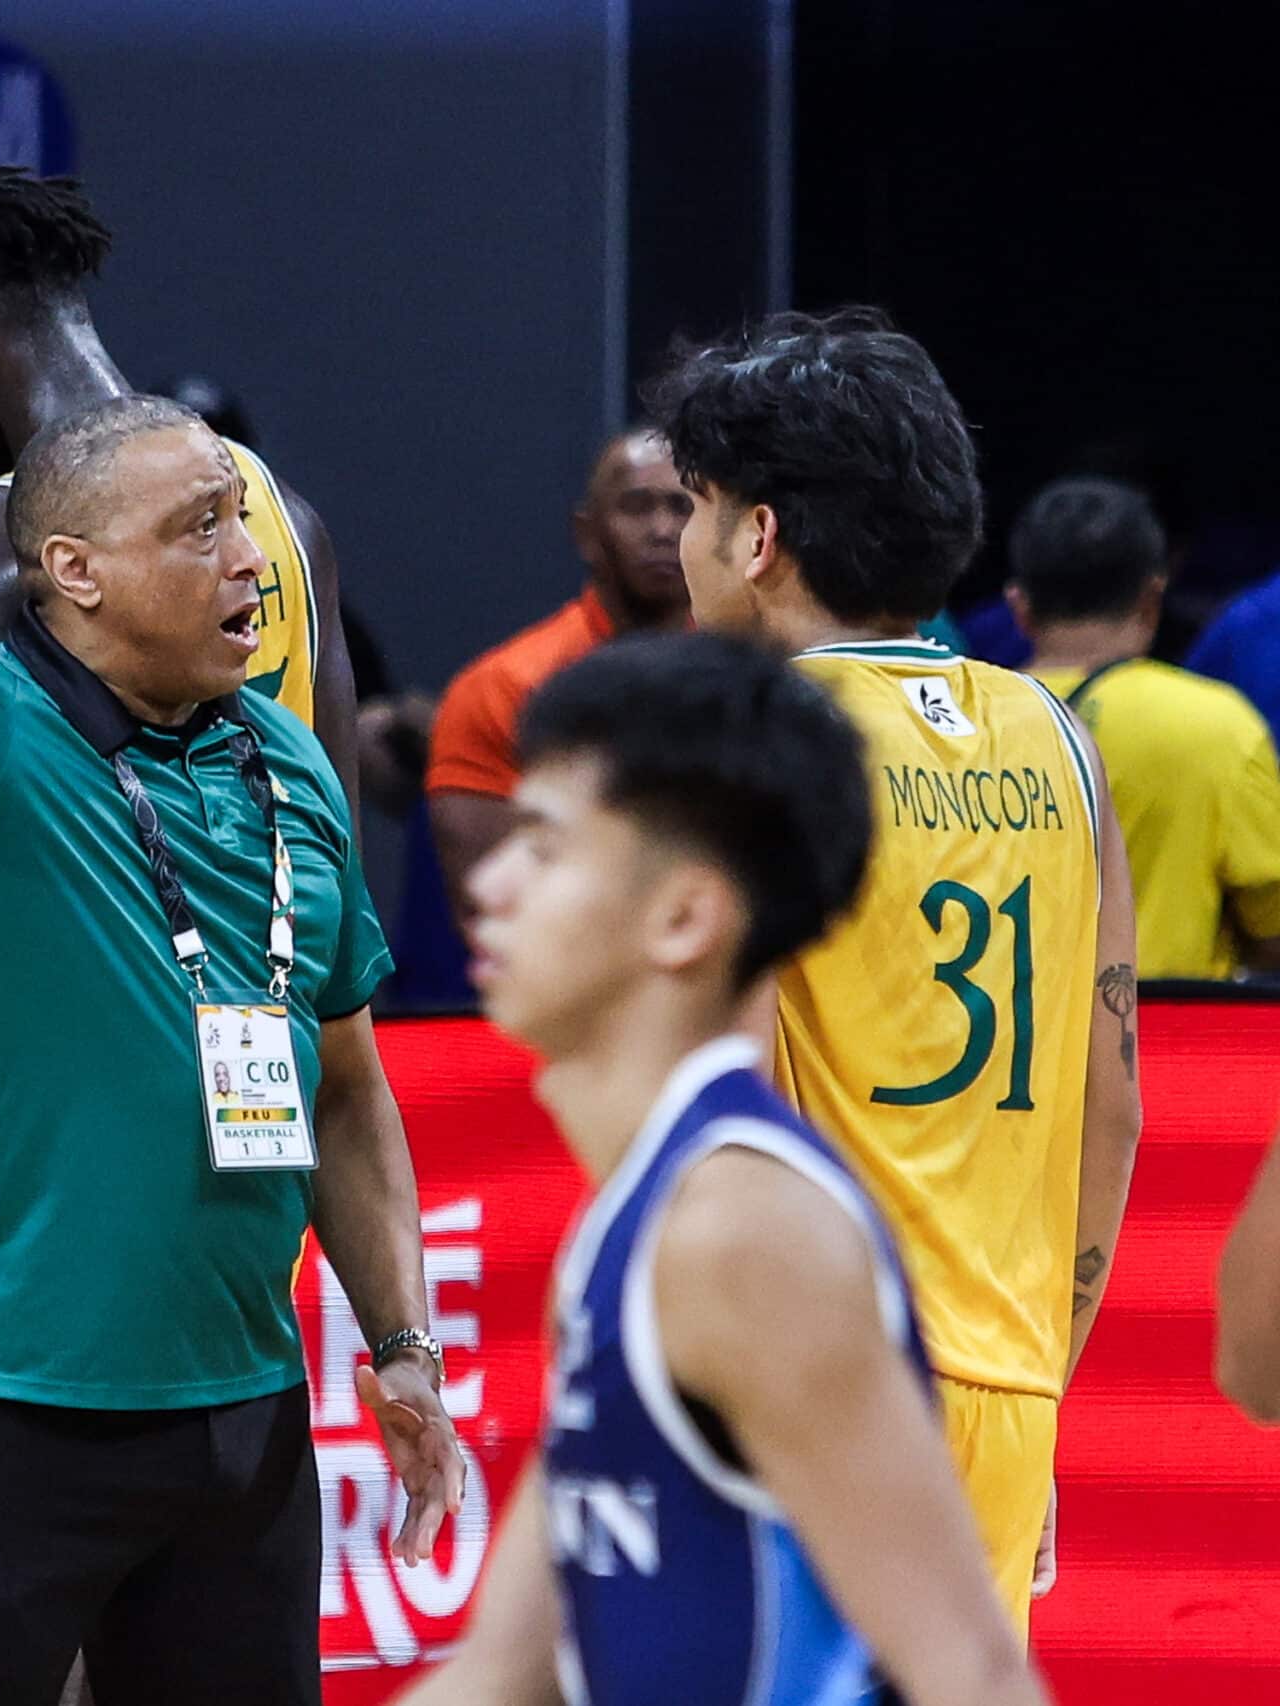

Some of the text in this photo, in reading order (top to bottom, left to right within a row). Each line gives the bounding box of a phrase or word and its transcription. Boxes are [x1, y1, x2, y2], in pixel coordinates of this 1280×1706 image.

[870, 874, 1035, 1112] 31
[241, 1110, 271, 1121] FEU
[224, 1127, 296, 1139] BASKETBALL
[242, 1141, 284, 1155] 1 3
